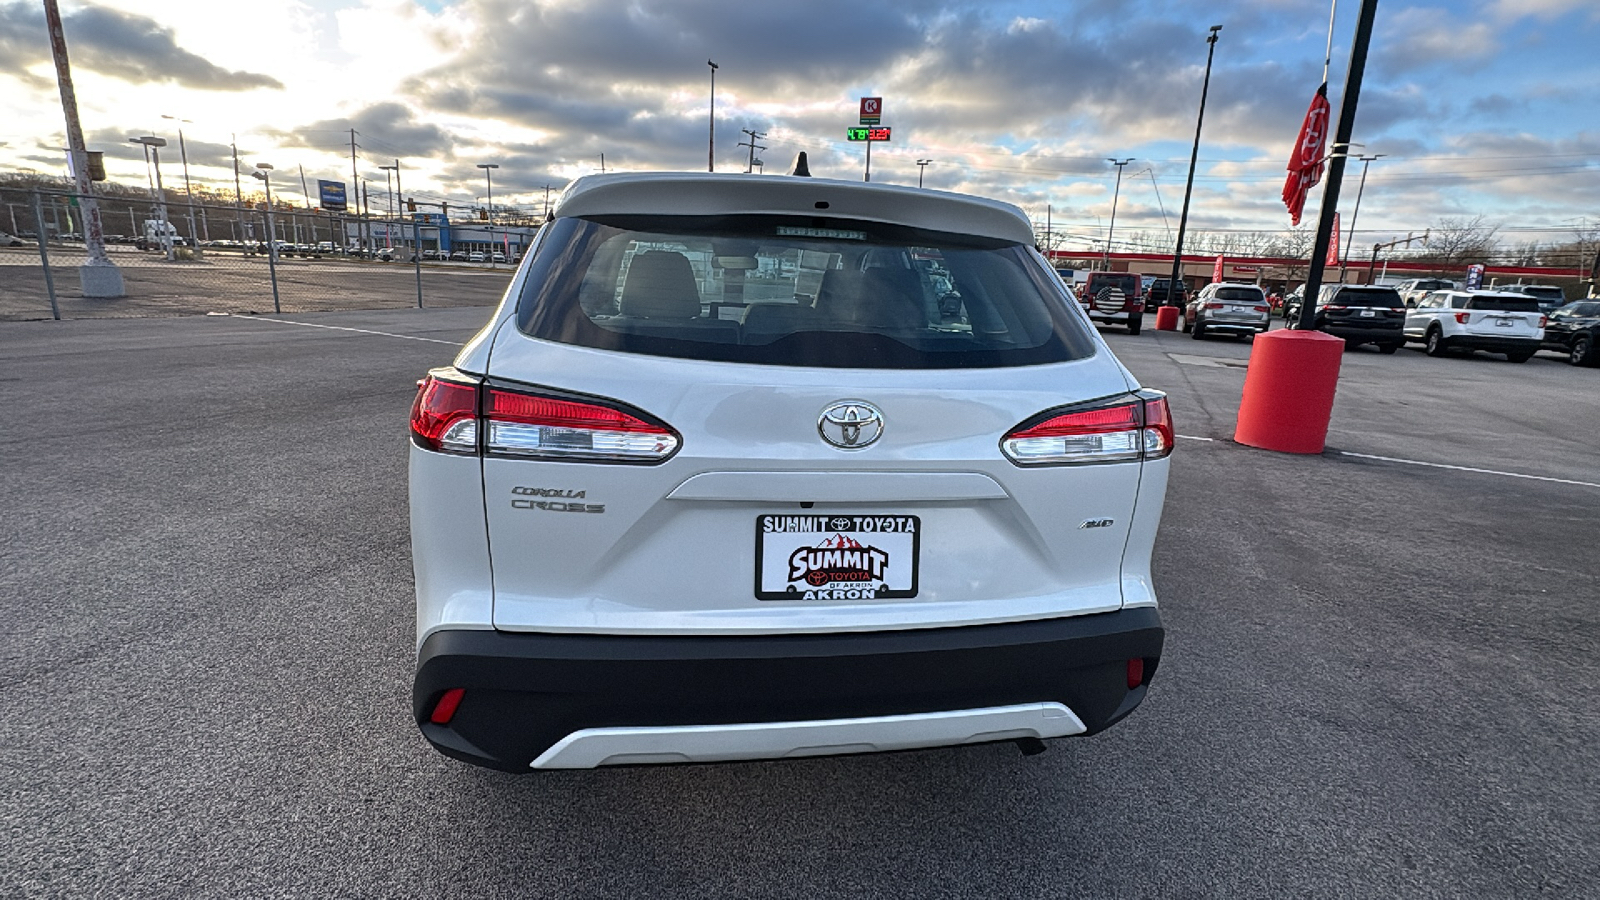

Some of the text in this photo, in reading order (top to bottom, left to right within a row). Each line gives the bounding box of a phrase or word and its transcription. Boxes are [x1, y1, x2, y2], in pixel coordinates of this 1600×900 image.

[511, 486, 586, 499] COROLLA
[511, 499, 605, 514] CROSS
[763, 516, 915, 533] SUMMIT TOYOTA
[791, 548, 886, 579] SUMMIT
[829, 571, 871, 580] TOYOTA
[802, 589, 876, 600] AKRON
